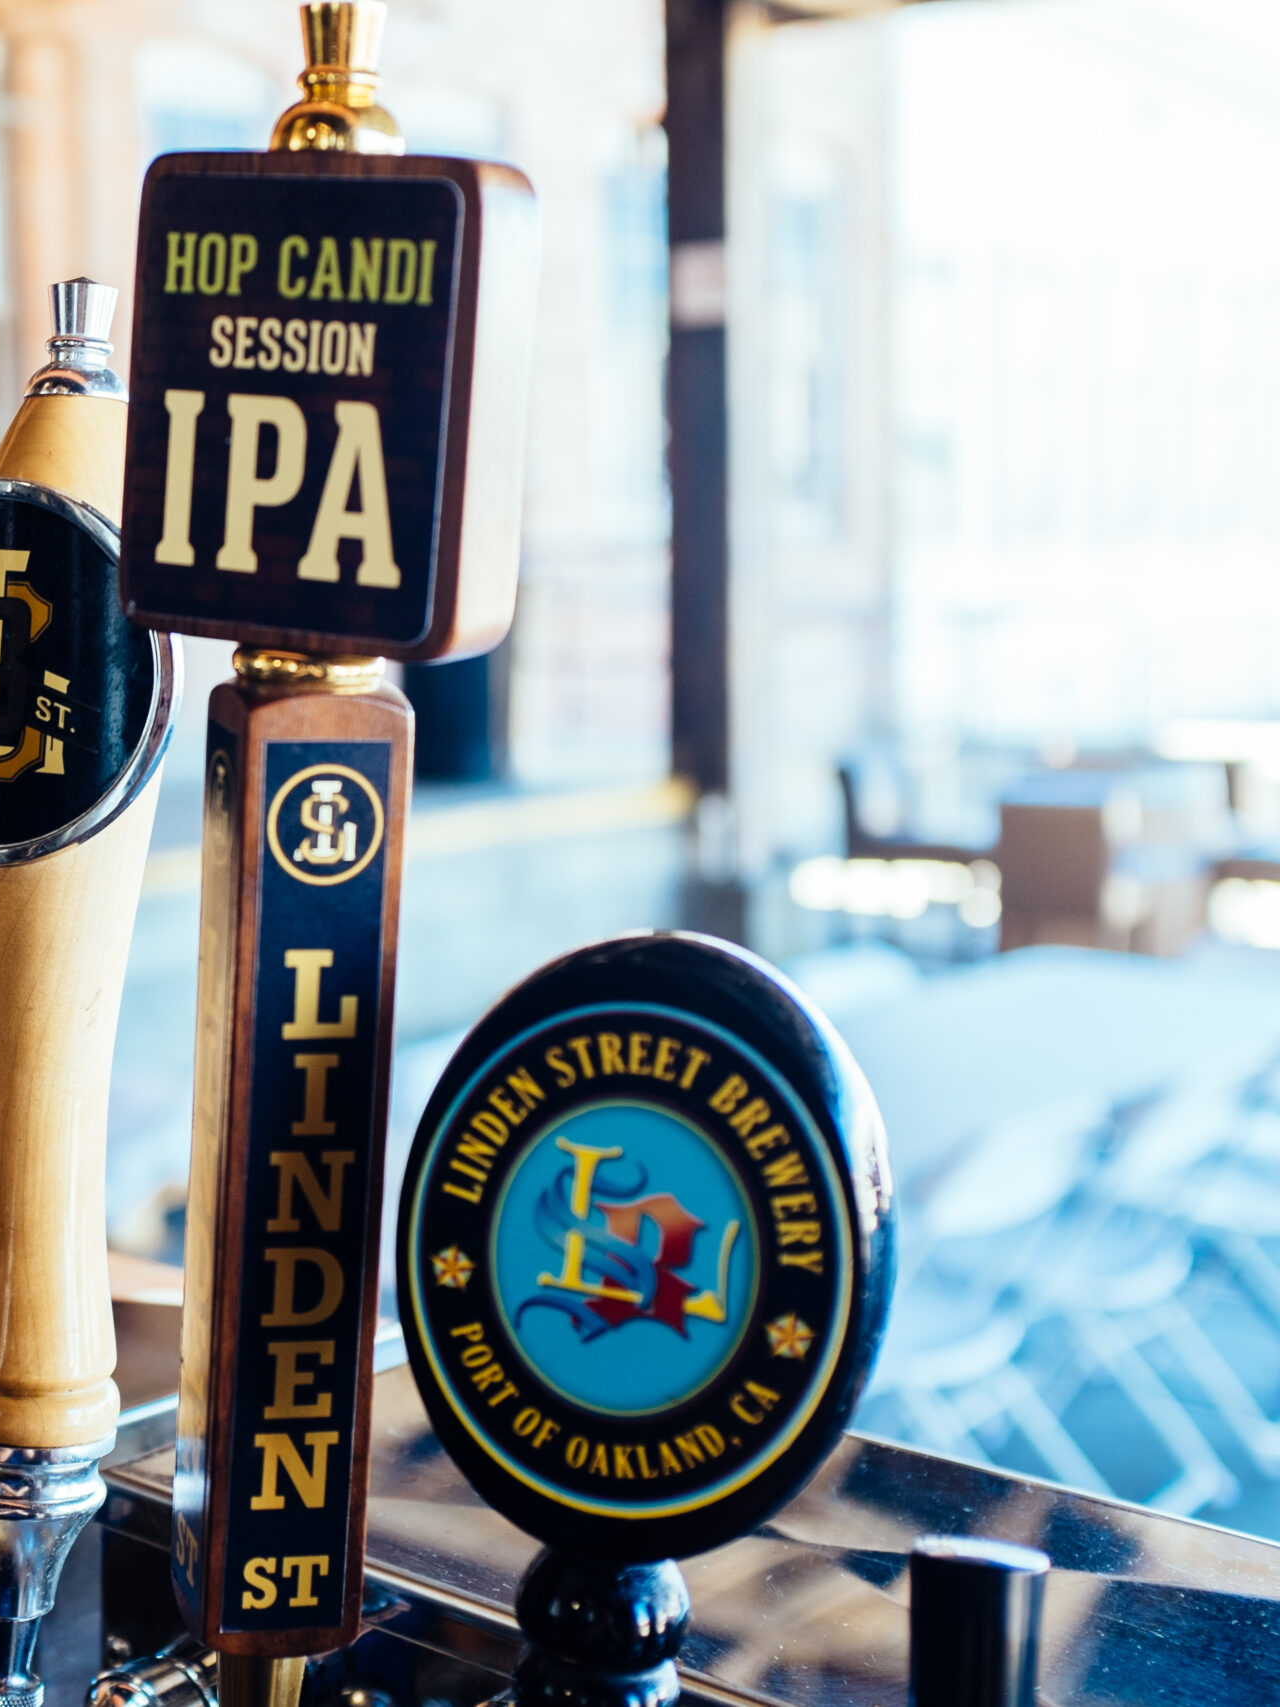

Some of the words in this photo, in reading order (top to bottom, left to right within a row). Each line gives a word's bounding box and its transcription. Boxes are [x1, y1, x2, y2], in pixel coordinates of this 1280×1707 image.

[163, 231, 258, 296] HOP
[277, 234, 437, 306] CANDI
[208, 314, 377, 378] SESSION
[154, 388, 402, 589] IPA
[34, 696, 76, 734] ST.
[441, 1065, 548, 1206] LINDEN
[543, 1031, 712, 1091] STREET
[706, 1071, 825, 1277] BREWERY
[250, 948, 358, 1511] LINDEN
[449, 1320, 521, 1409] PORT
[510, 1405, 563, 1450] OF
[727, 1379, 793, 1427] CA
[175, 1511, 200, 1588] ST
[241, 1553, 331, 1612] ST
